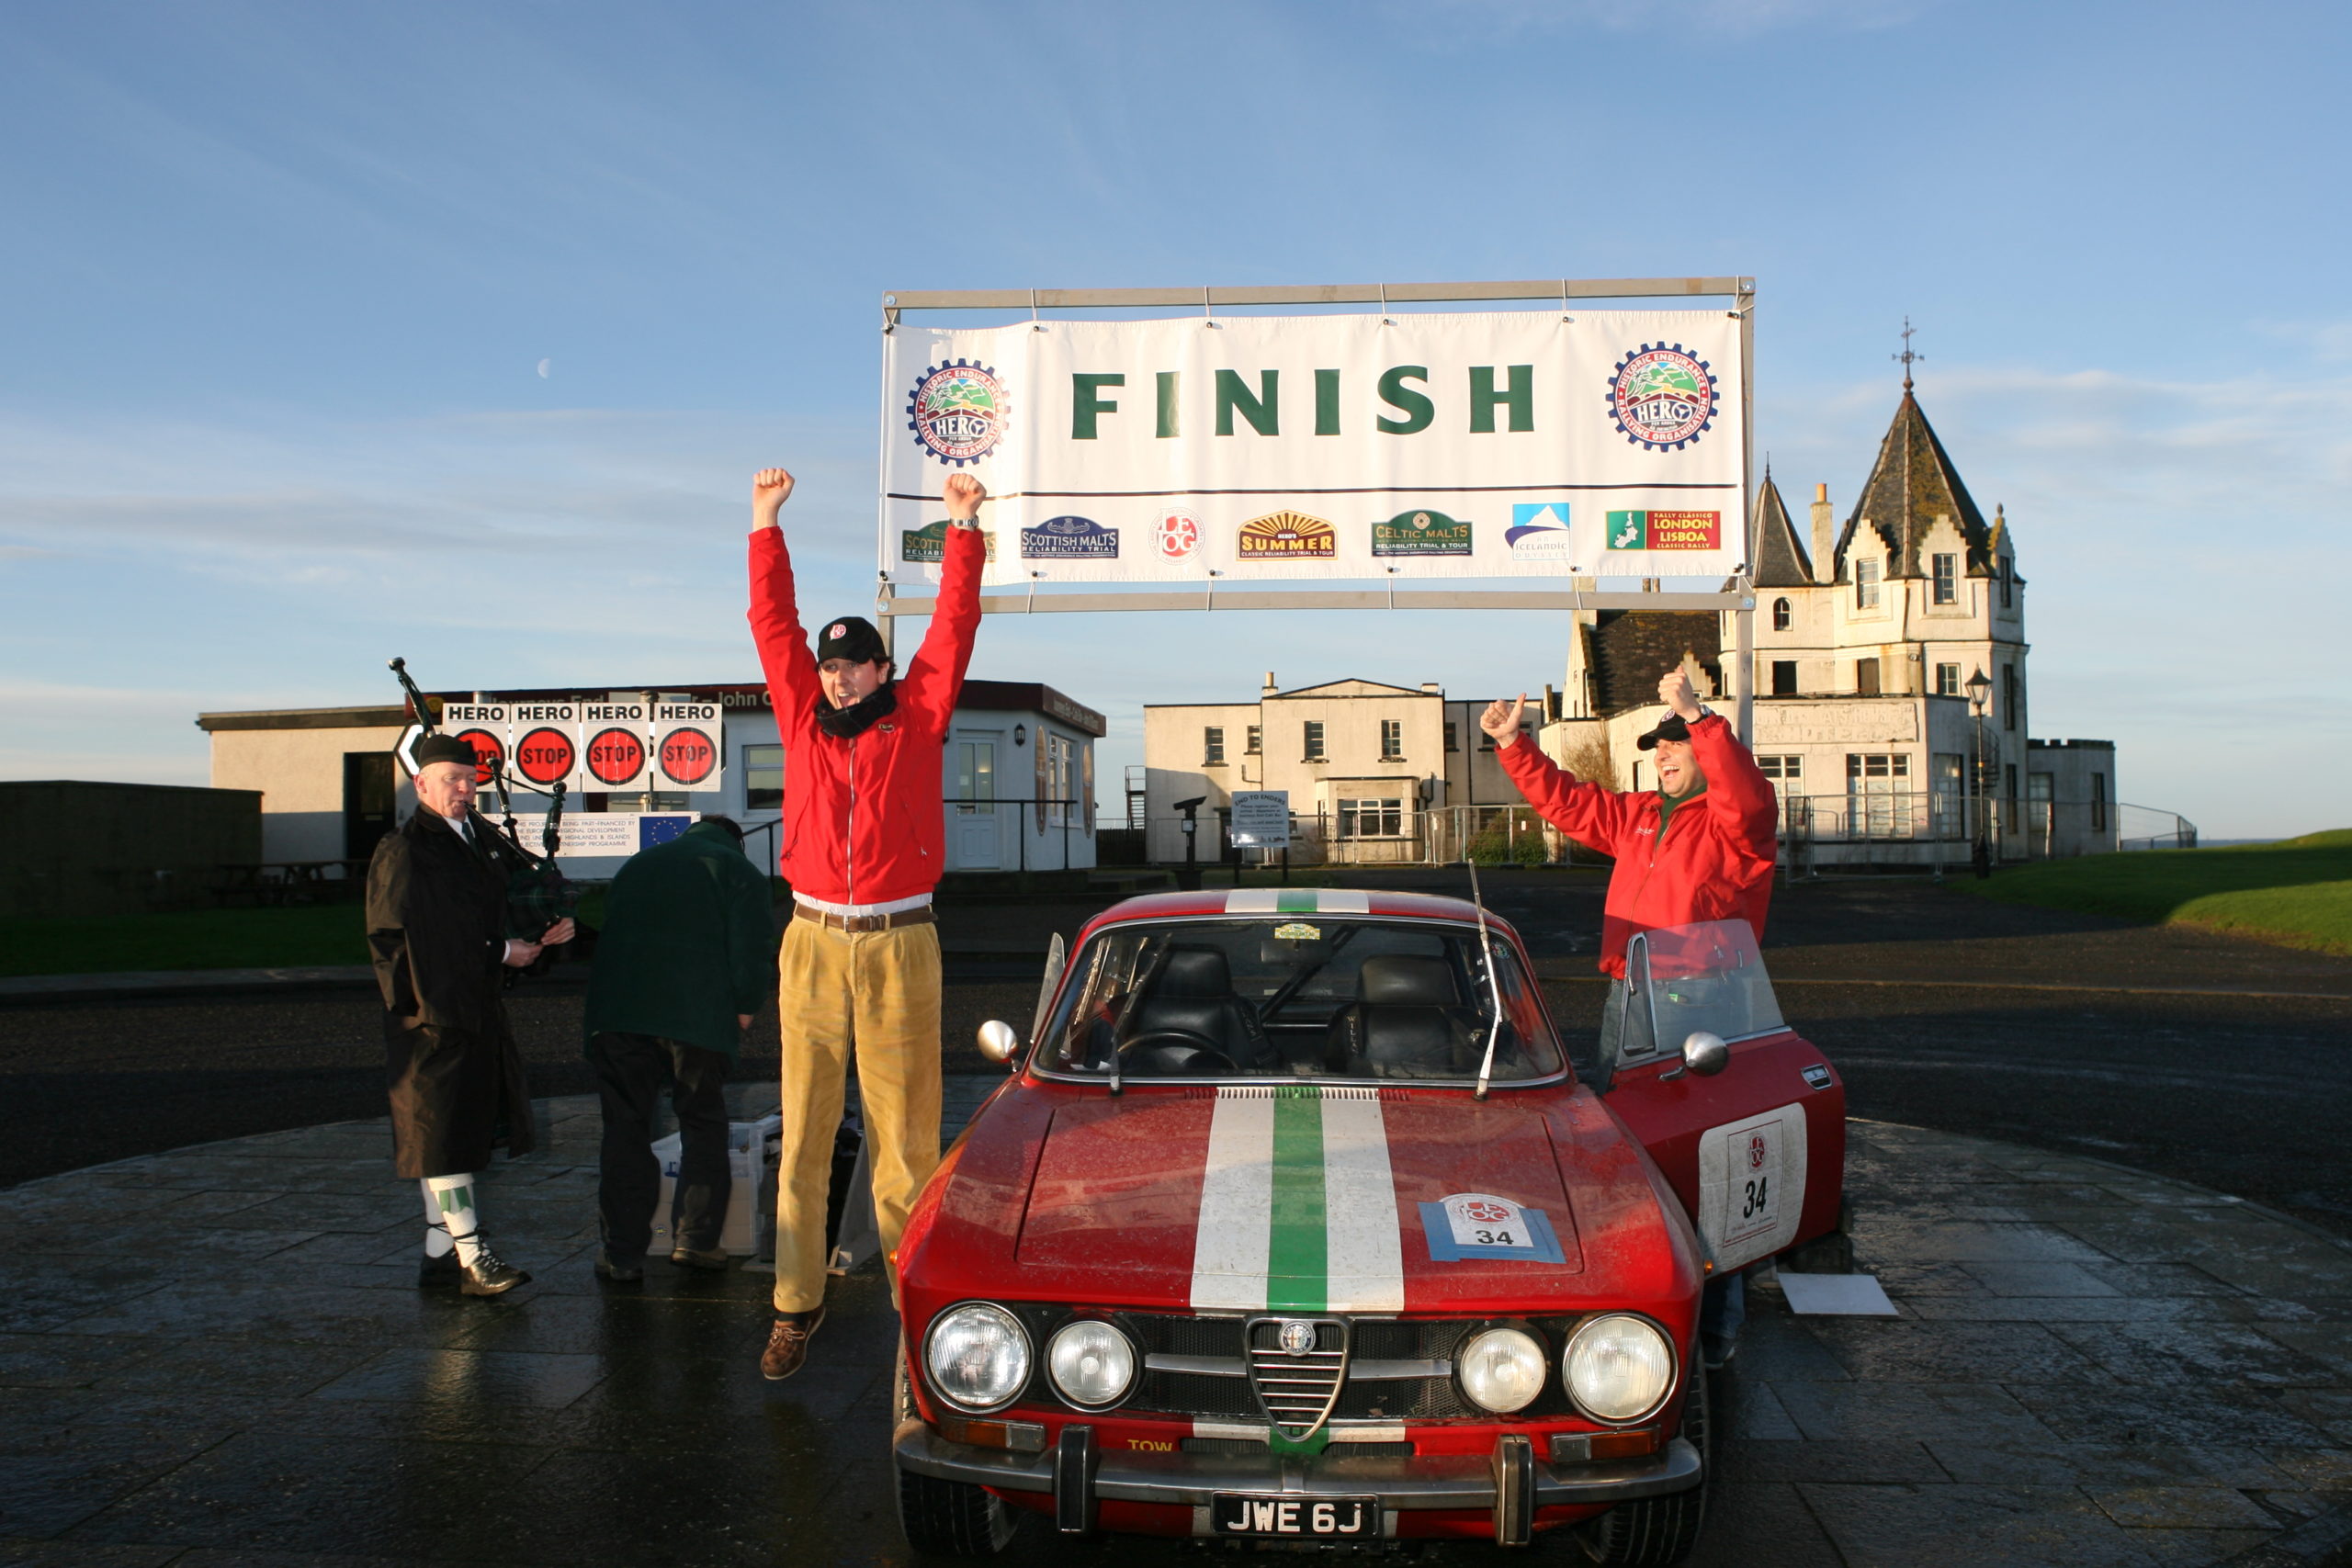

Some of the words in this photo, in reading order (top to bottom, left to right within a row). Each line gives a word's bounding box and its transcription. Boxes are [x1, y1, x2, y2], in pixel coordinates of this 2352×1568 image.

[1619, 355, 1653, 389] HISTORIC
[1654, 353, 1707, 389] ENDURANCE
[919, 370, 953, 403] HISTORIC
[954, 369, 1001, 400] ENDURANCE
[1071, 365, 1534, 439] FINISH
[1617, 399, 1650, 438] RALLYING
[1652, 396, 1709, 441] ORGANISATION
[1636, 400, 1692, 423] HERO
[917, 412, 948, 453] RALLYING
[935, 416, 988, 438] HERO
[1375, 525, 1422, 538] CELTIC
[1426, 525, 1468, 538] MALTS
[1654, 518, 1713, 530] LONDON
[905, 534, 944, 550] SCOTTI
[1022, 531, 1078, 547] SCOTTISH
[1080, 531, 1116, 547] MALTS
[1241, 535, 1333, 551] SUMMER
[1659, 531, 1708, 542] LISBOA
[905, 548, 944, 557] RELIABI
[448, 706, 504, 721] HERO
[517, 706, 573, 720] HERO
[587, 705, 643, 720] HERO
[660, 705, 716, 720] HERO
[475, 750, 498, 766] OP
[523, 748, 568, 764] STOP
[593, 746, 637, 762] STOP
[664, 745, 708, 761] STOP
[1744, 1177, 1767, 1219] 34
[1476, 1230, 1514, 1246] 34
[1126, 1438, 1173, 1451] TOW
[1227, 1501, 1301, 1533] JWE
[1312, 1503, 1362, 1533] 6J
